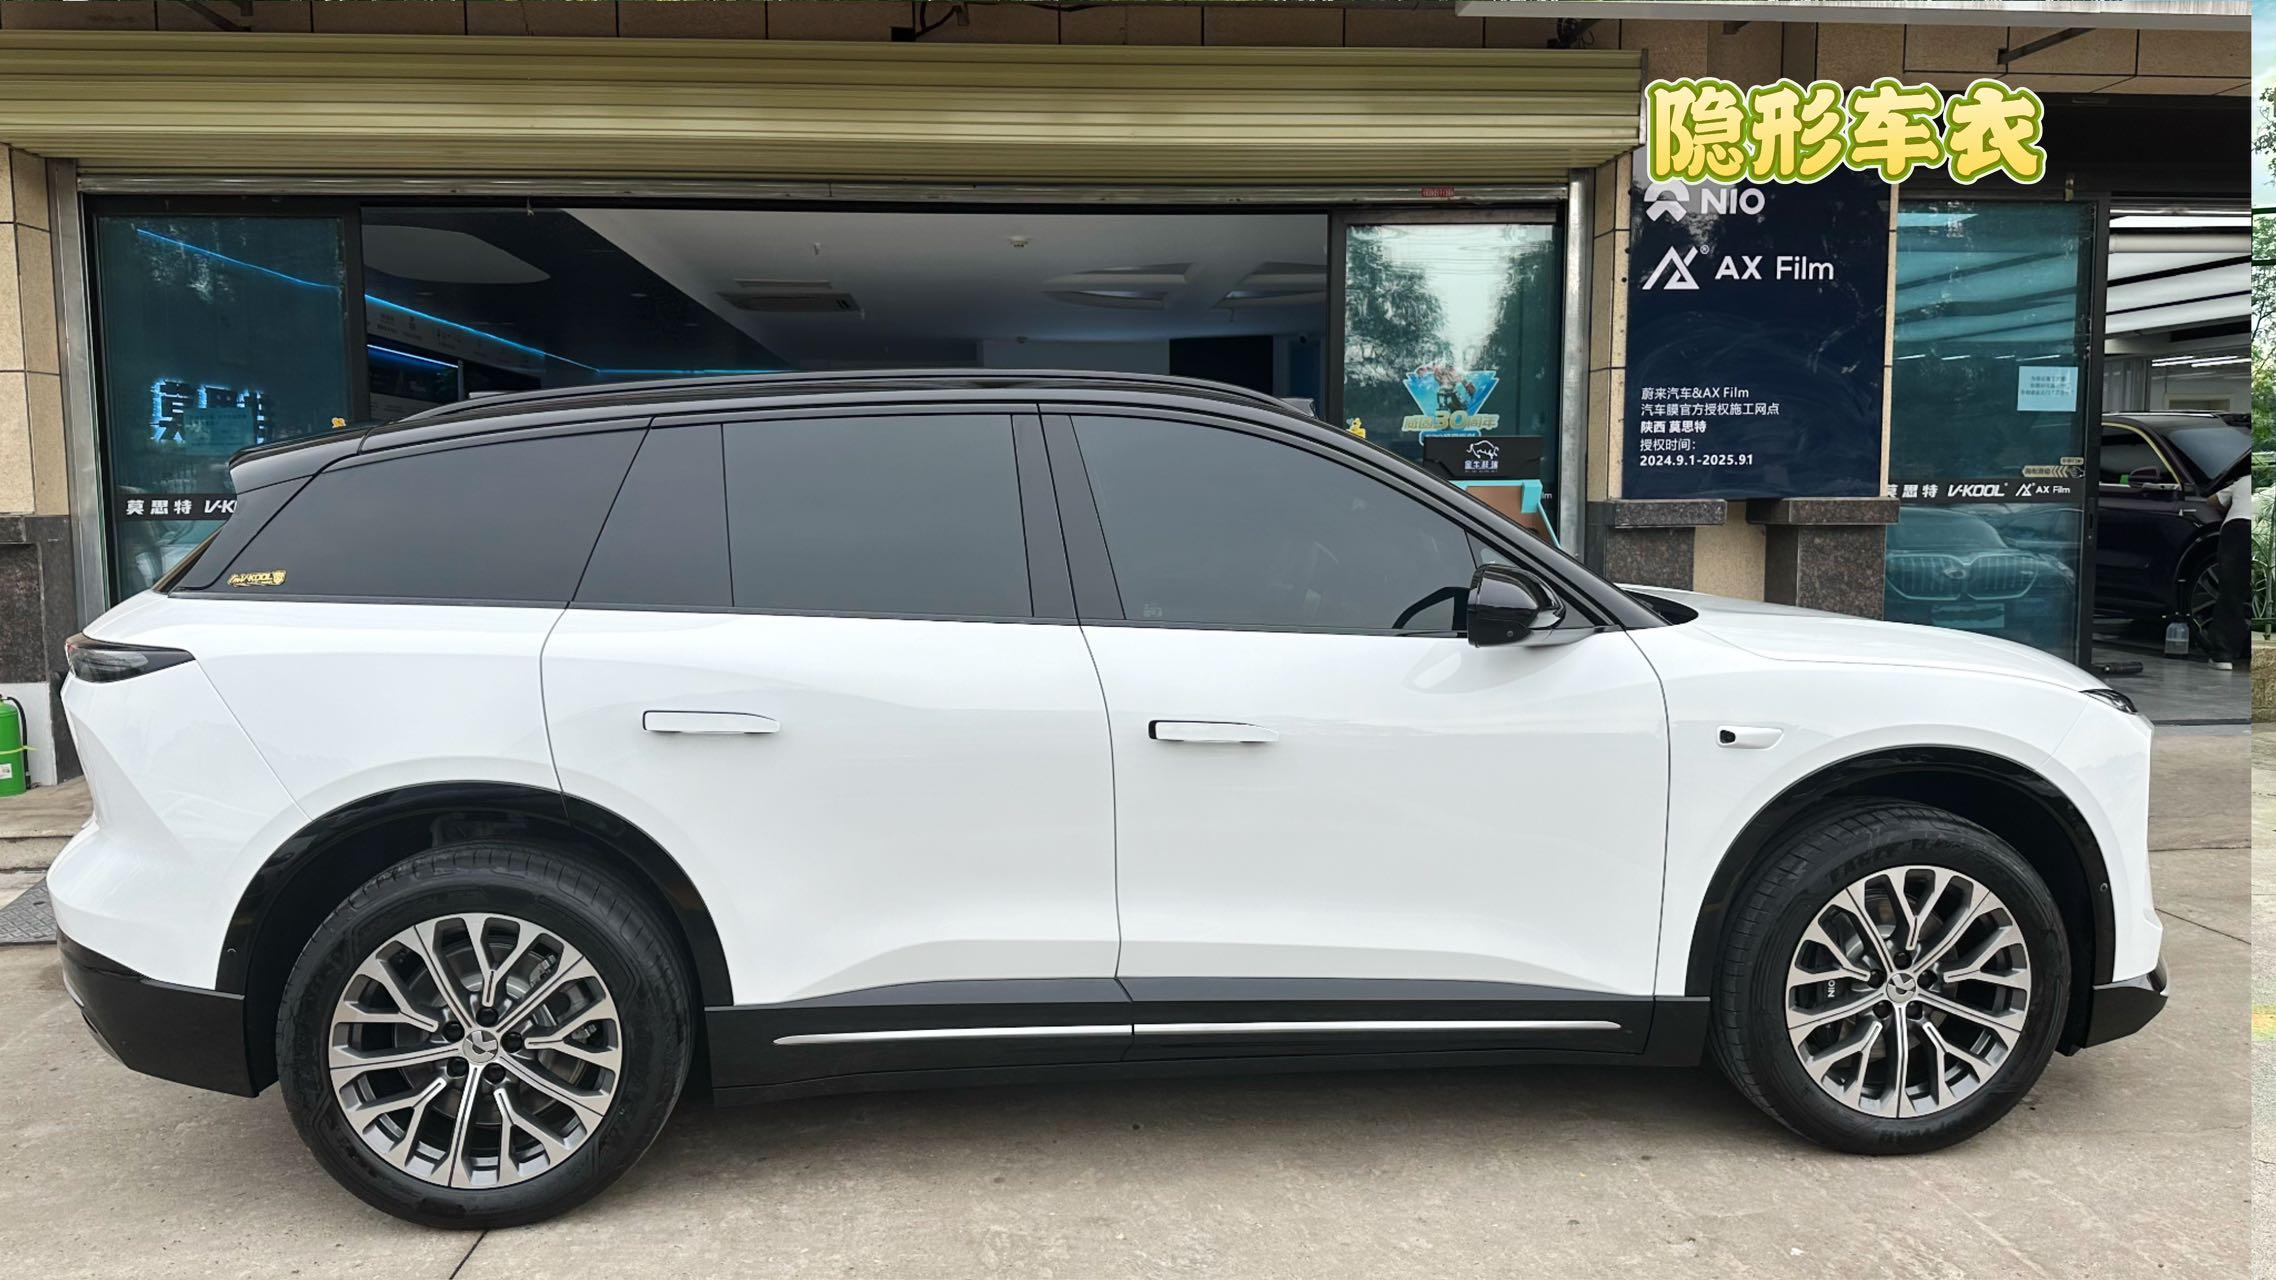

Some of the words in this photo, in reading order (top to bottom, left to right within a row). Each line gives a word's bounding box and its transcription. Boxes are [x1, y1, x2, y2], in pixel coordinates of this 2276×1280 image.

[1701, 187, 1765, 215] NIO
[1714, 255, 1763, 280] AX
[1776, 255, 1834, 280] Film
[1723, 386, 1749, 398] Film
[1641, 402, 1779, 416] 汽车膜官方授权施工网点
[1640, 420, 1666, 433] 陕西
[1668, 420, 1707, 433] 莫思特
[2053, 486, 2071, 494] Film
[126, 499, 192, 515] 莫思特
